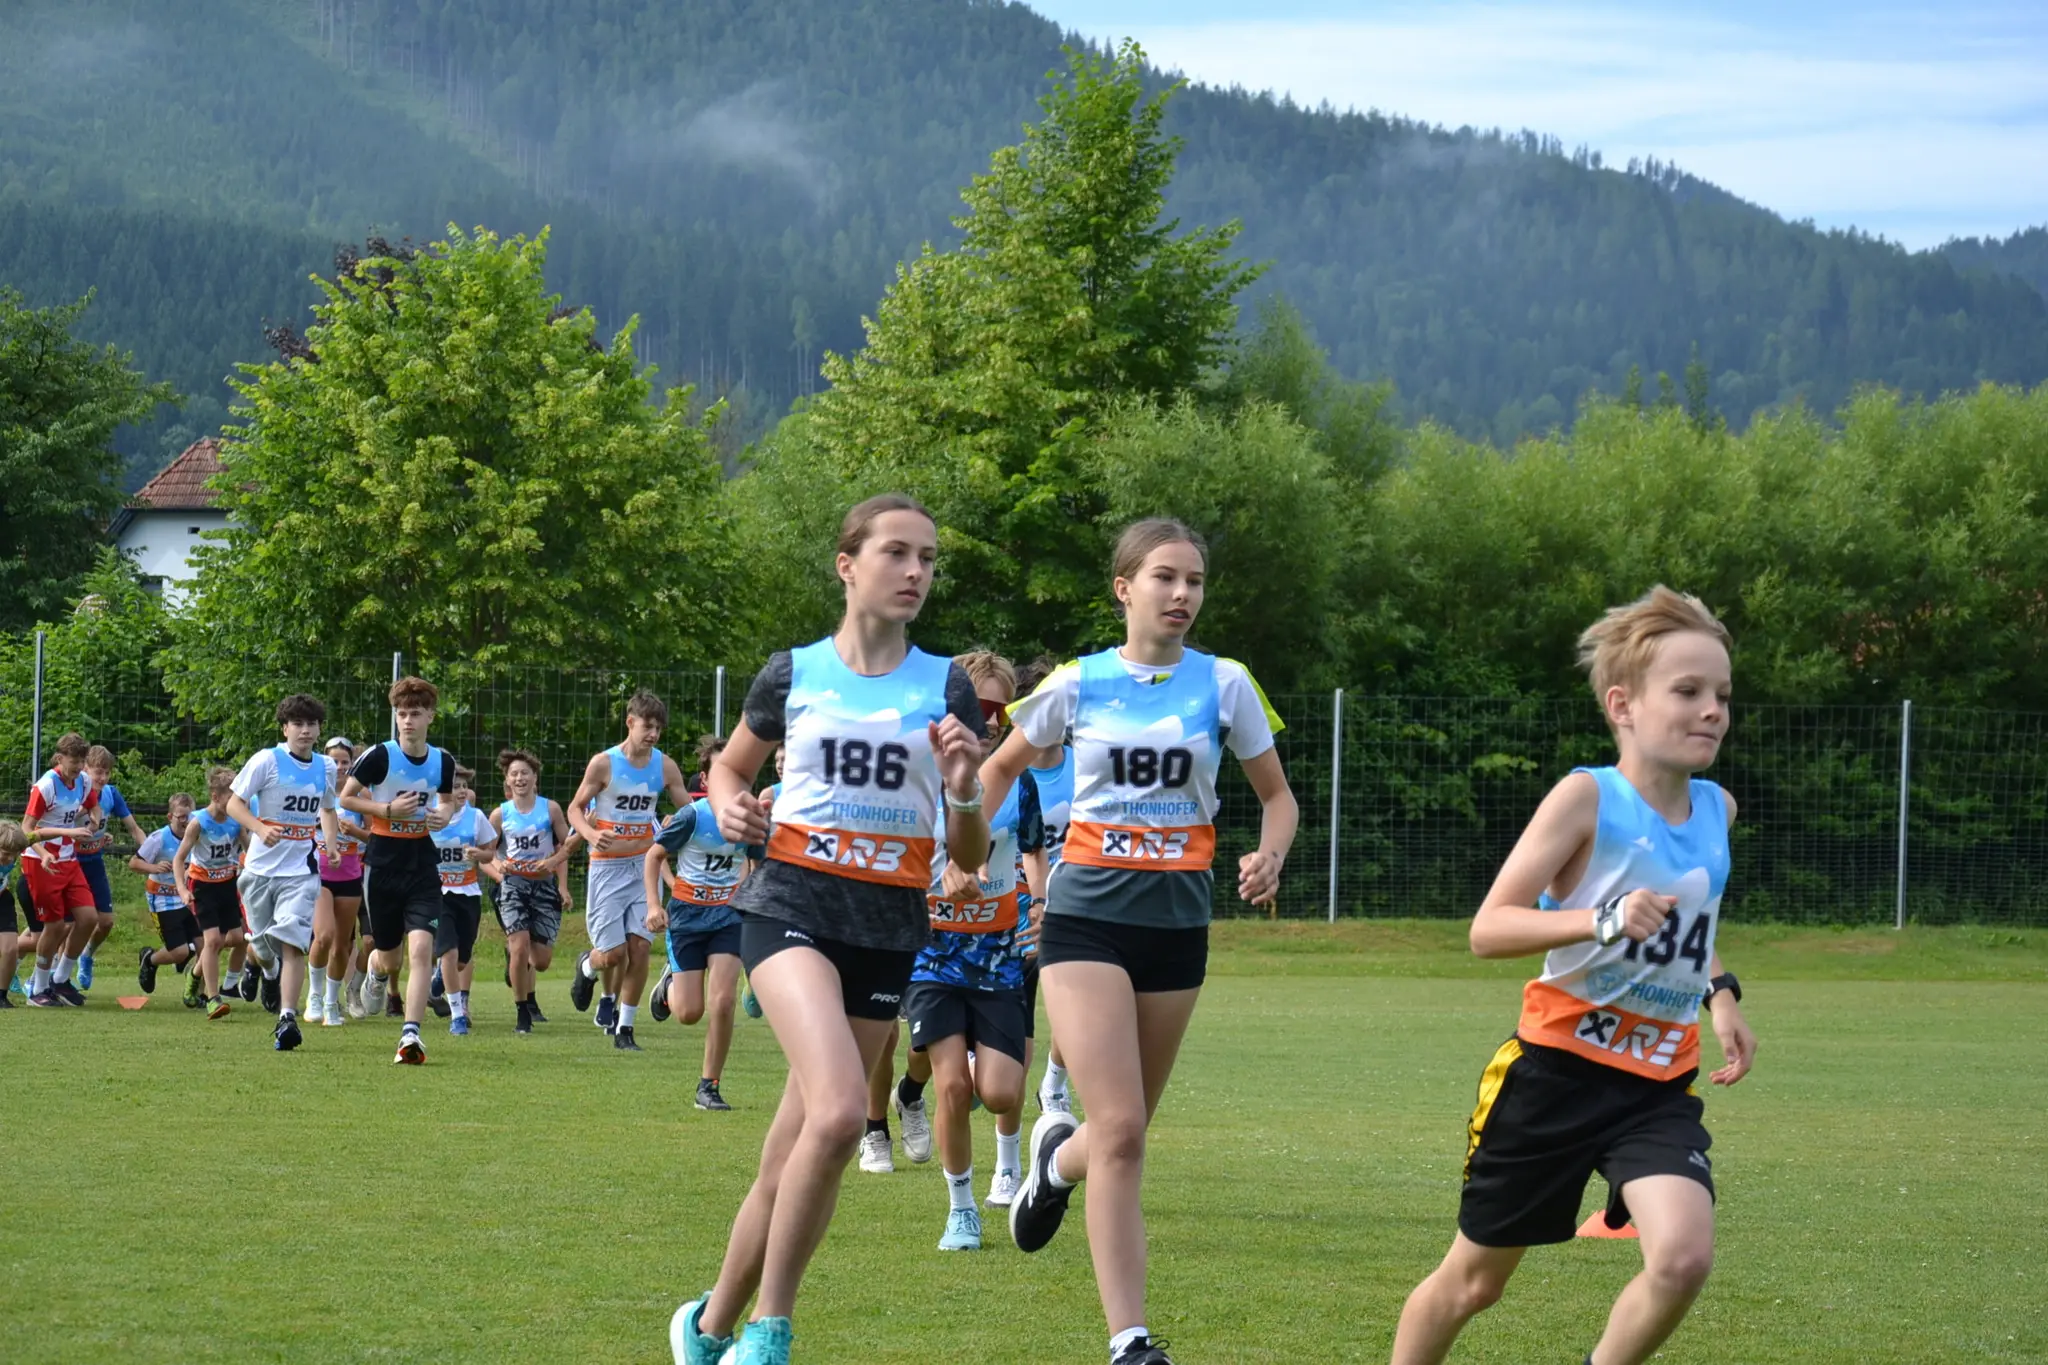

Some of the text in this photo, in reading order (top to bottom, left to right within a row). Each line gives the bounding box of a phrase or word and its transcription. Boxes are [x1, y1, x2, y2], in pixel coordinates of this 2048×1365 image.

[820, 736, 911, 791] 186
[1108, 746, 1194, 789] 180
[283, 795, 320, 813] 200
[615, 795, 652, 811] 205
[1120, 800, 1198, 817] THONHOFER
[63, 809, 79, 824] 19
[830, 802, 918, 825] THONHOFER
[515, 834, 541, 851] 184
[704, 853, 733, 872] 174
[870, 993, 900, 1004] PRO
